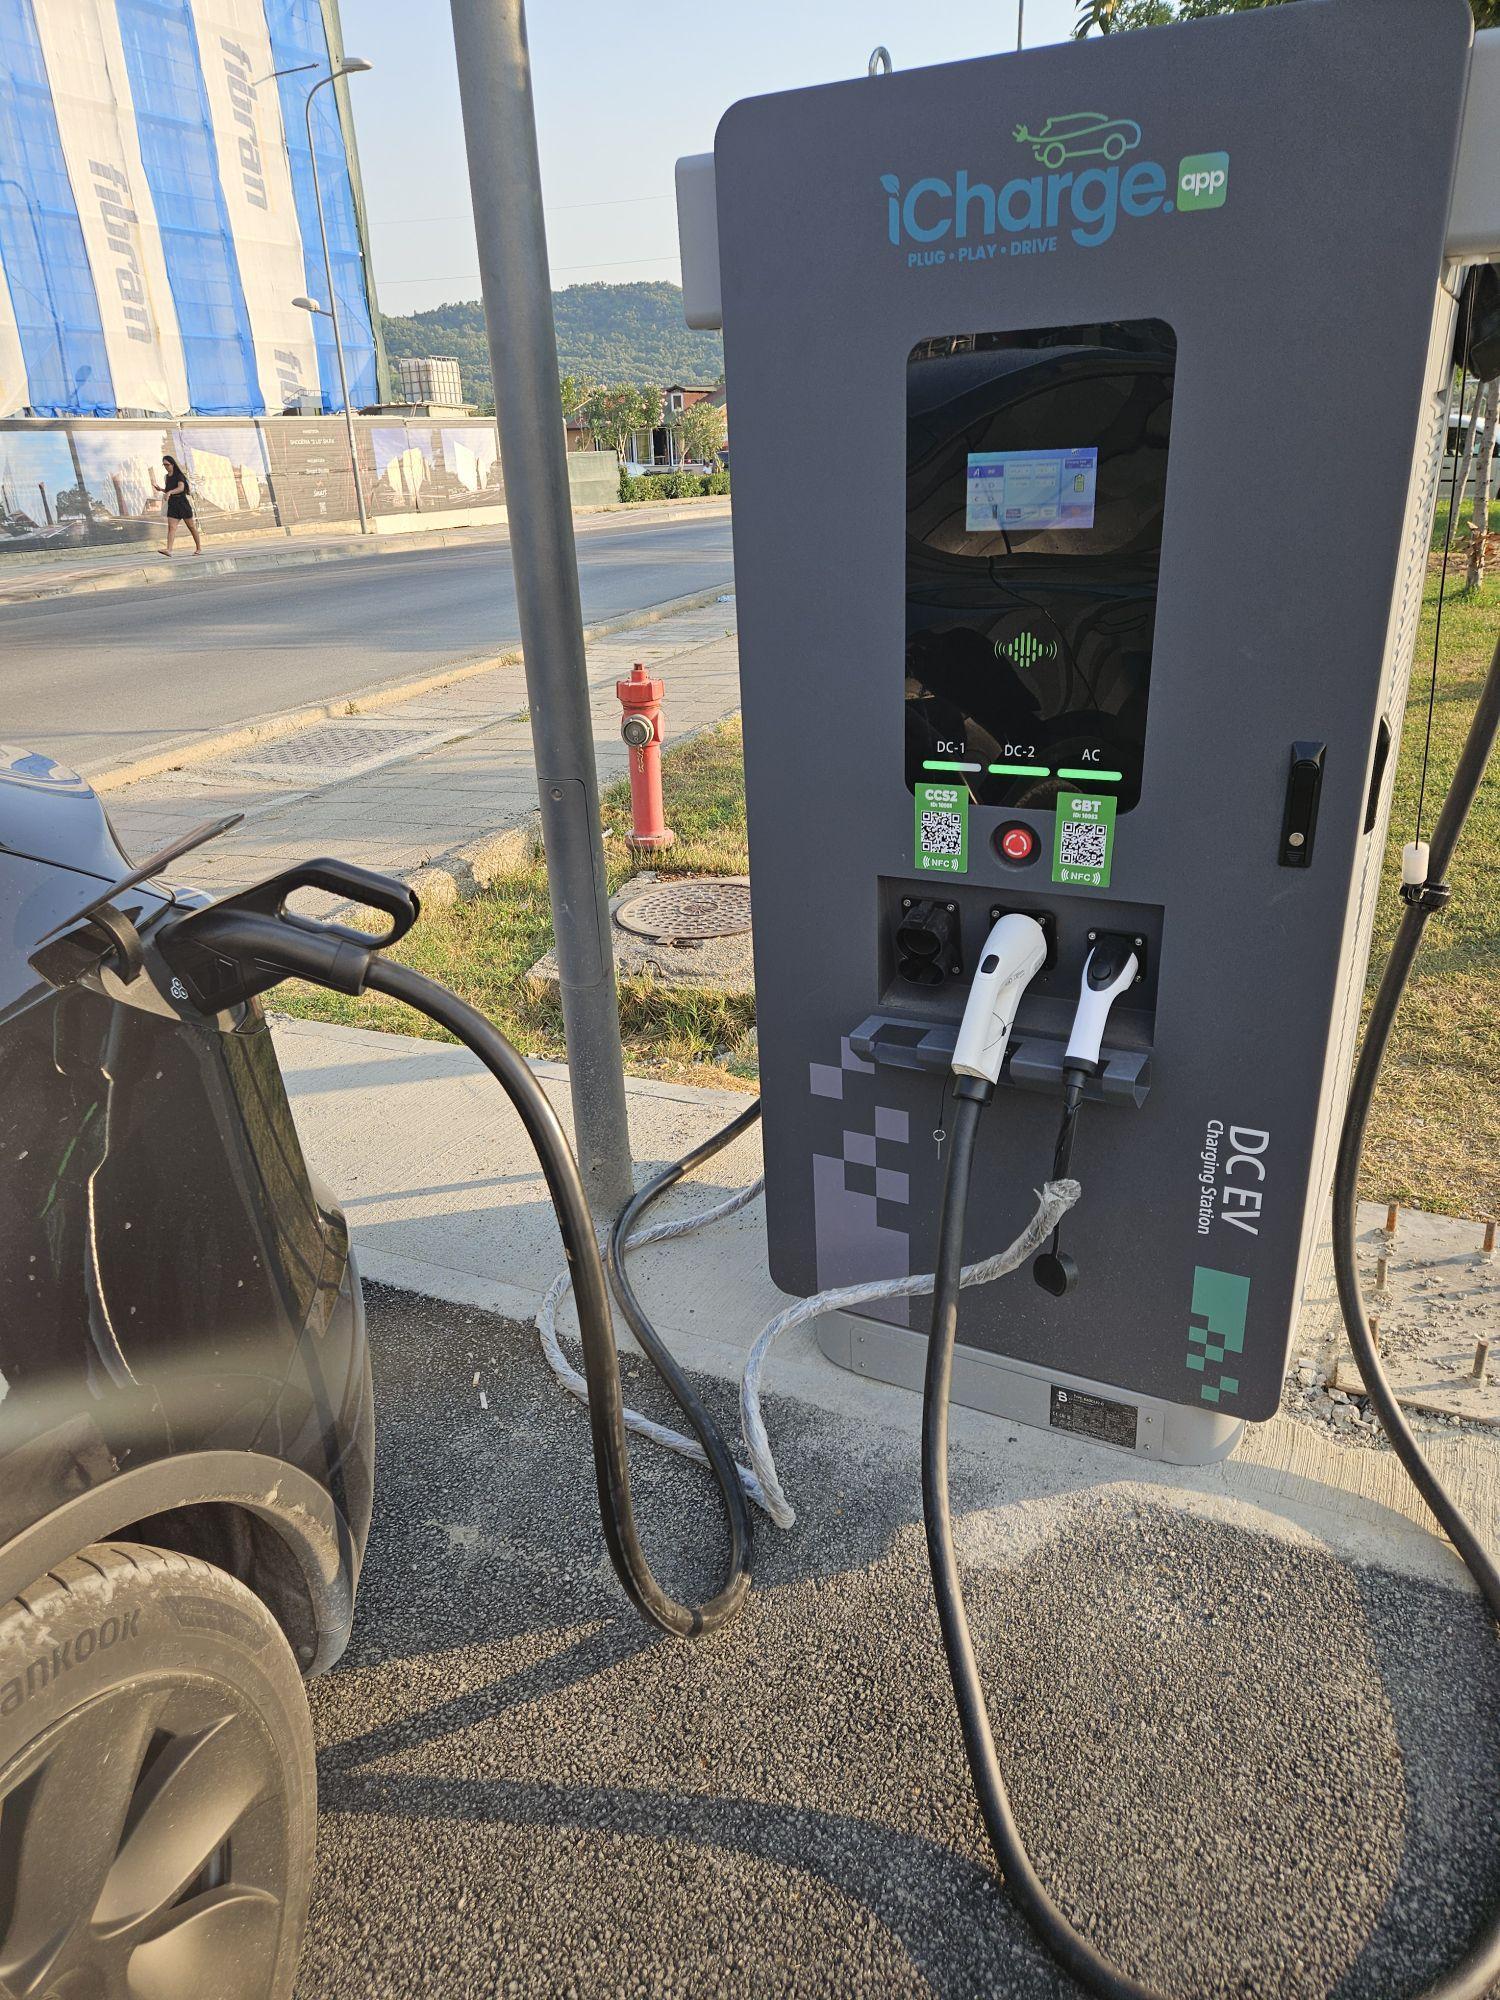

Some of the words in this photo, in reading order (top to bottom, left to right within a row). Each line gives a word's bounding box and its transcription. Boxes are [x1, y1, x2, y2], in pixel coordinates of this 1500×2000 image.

[220, 35, 268, 211] fibran
[1180, 168, 1225, 198] app
[88, 158, 152, 345] fibran
[907, 247, 946, 268] PLUG
[958, 244, 997, 263] PLAY
[1010, 236, 1058, 256] DRIVE
[937, 740, 966, 754] DC-1
[1004, 744, 1035, 758] DC-2
[1081, 748, 1100, 762] AC
[924, 788, 958, 802] CCS2
[1071, 798, 1102, 813] GBT
[931, 858, 950, 868] NFC
[1070, 871, 1091, 881] NFC
[1198, 1119, 1224, 1184] Charging
[1225, 1125, 1270, 1182] DC
[1197, 1186, 1217, 1235] Station
[1221, 1186, 1263, 1236] EV
